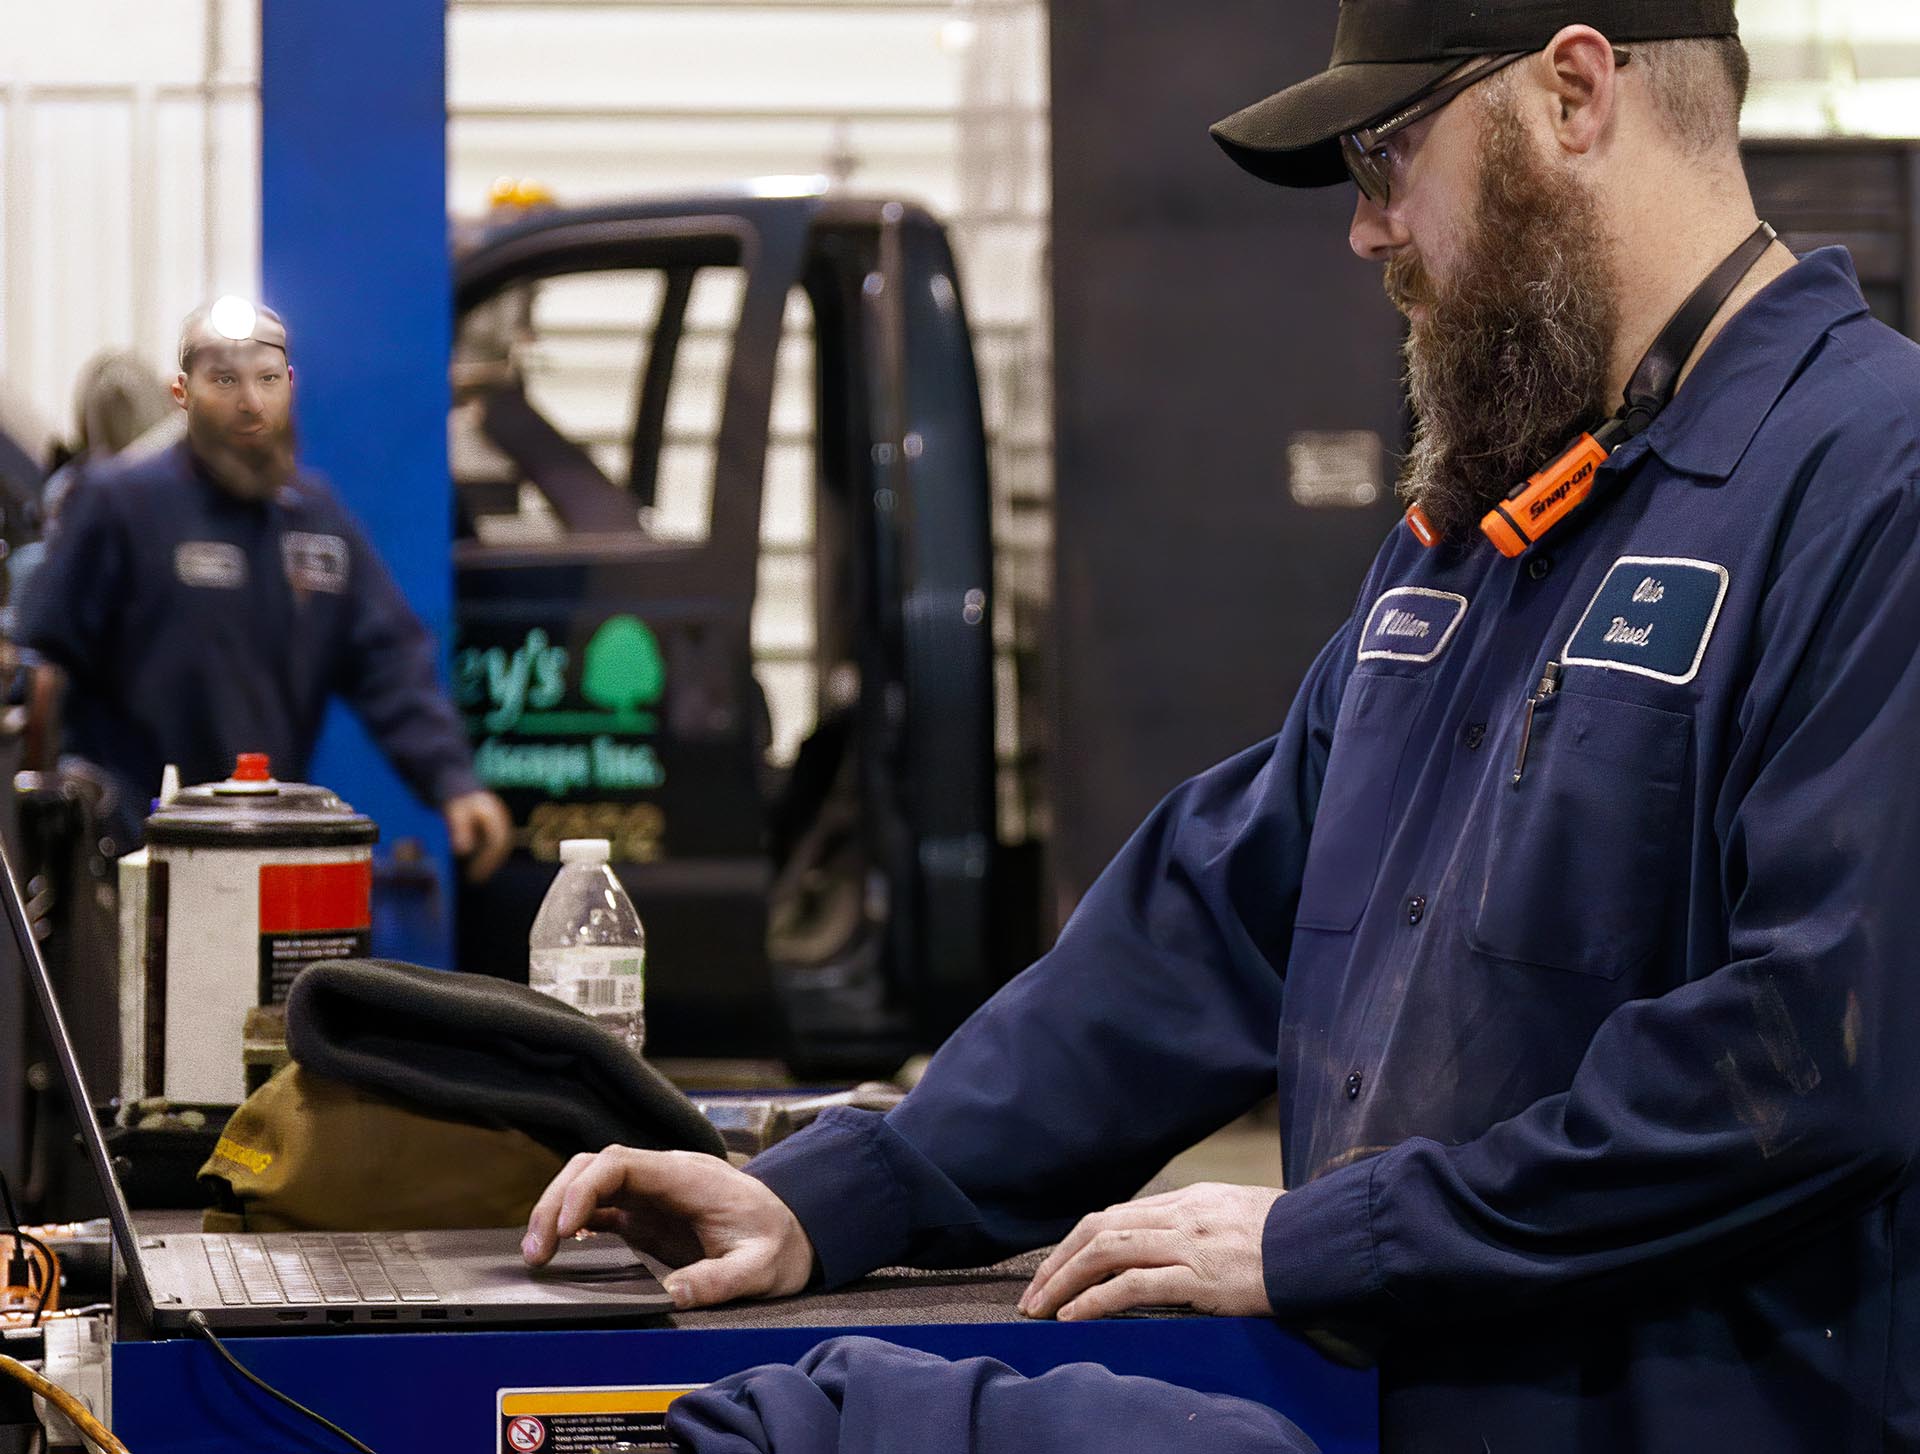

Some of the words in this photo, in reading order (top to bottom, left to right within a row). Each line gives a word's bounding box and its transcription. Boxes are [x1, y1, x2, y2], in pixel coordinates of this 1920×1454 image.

[1529, 461, 1593, 521] Snap-on
[1376, 608, 1430, 638] William
[1603, 616, 1653, 646] Diesel
